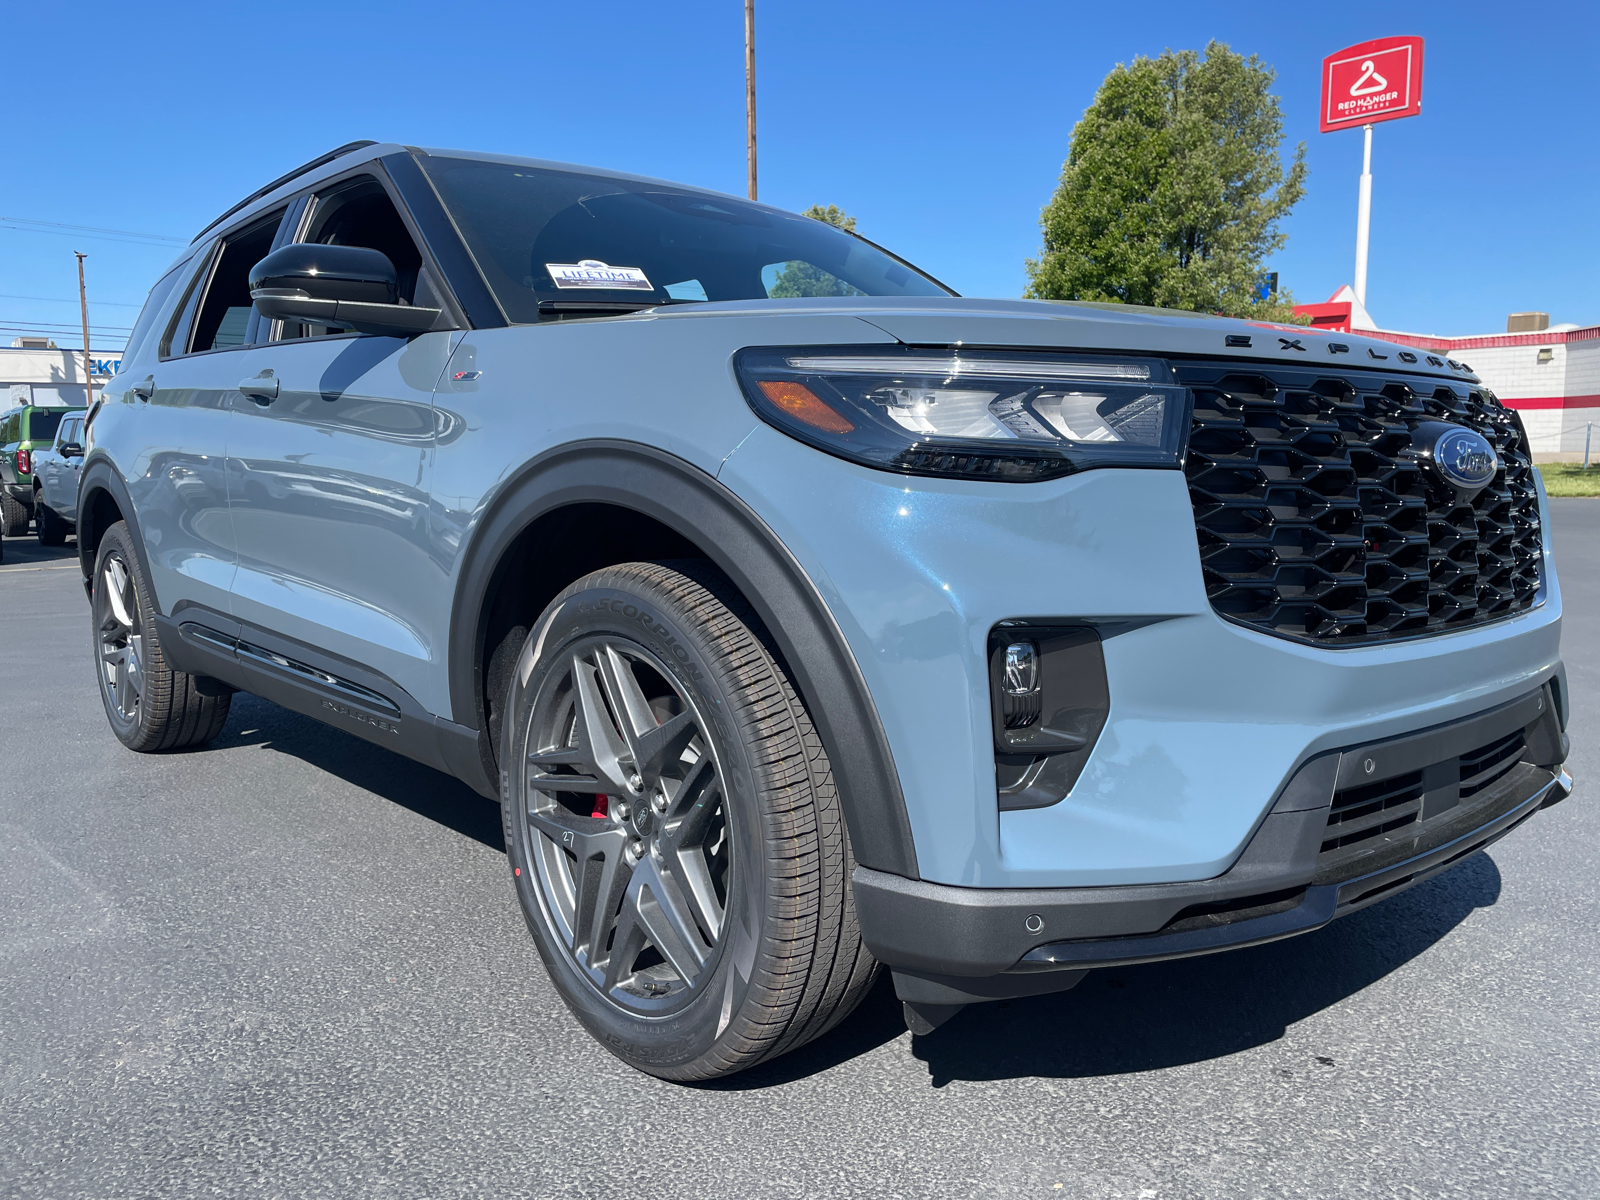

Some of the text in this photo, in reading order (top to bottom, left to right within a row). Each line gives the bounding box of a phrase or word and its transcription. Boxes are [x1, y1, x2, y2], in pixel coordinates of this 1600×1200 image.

[1338, 91, 1398, 111] RED HANGER
[1345, 101, 1389, 115] CLEANERS
[562, 271, 635, 280] LIFETIME
[595, 597, 704, 681] SCORPION
[320, 698, 400, 735] EXPLORER
[702, 694, 747, 797] ZERO
[501, 768, 513, 846] PIRELLI
